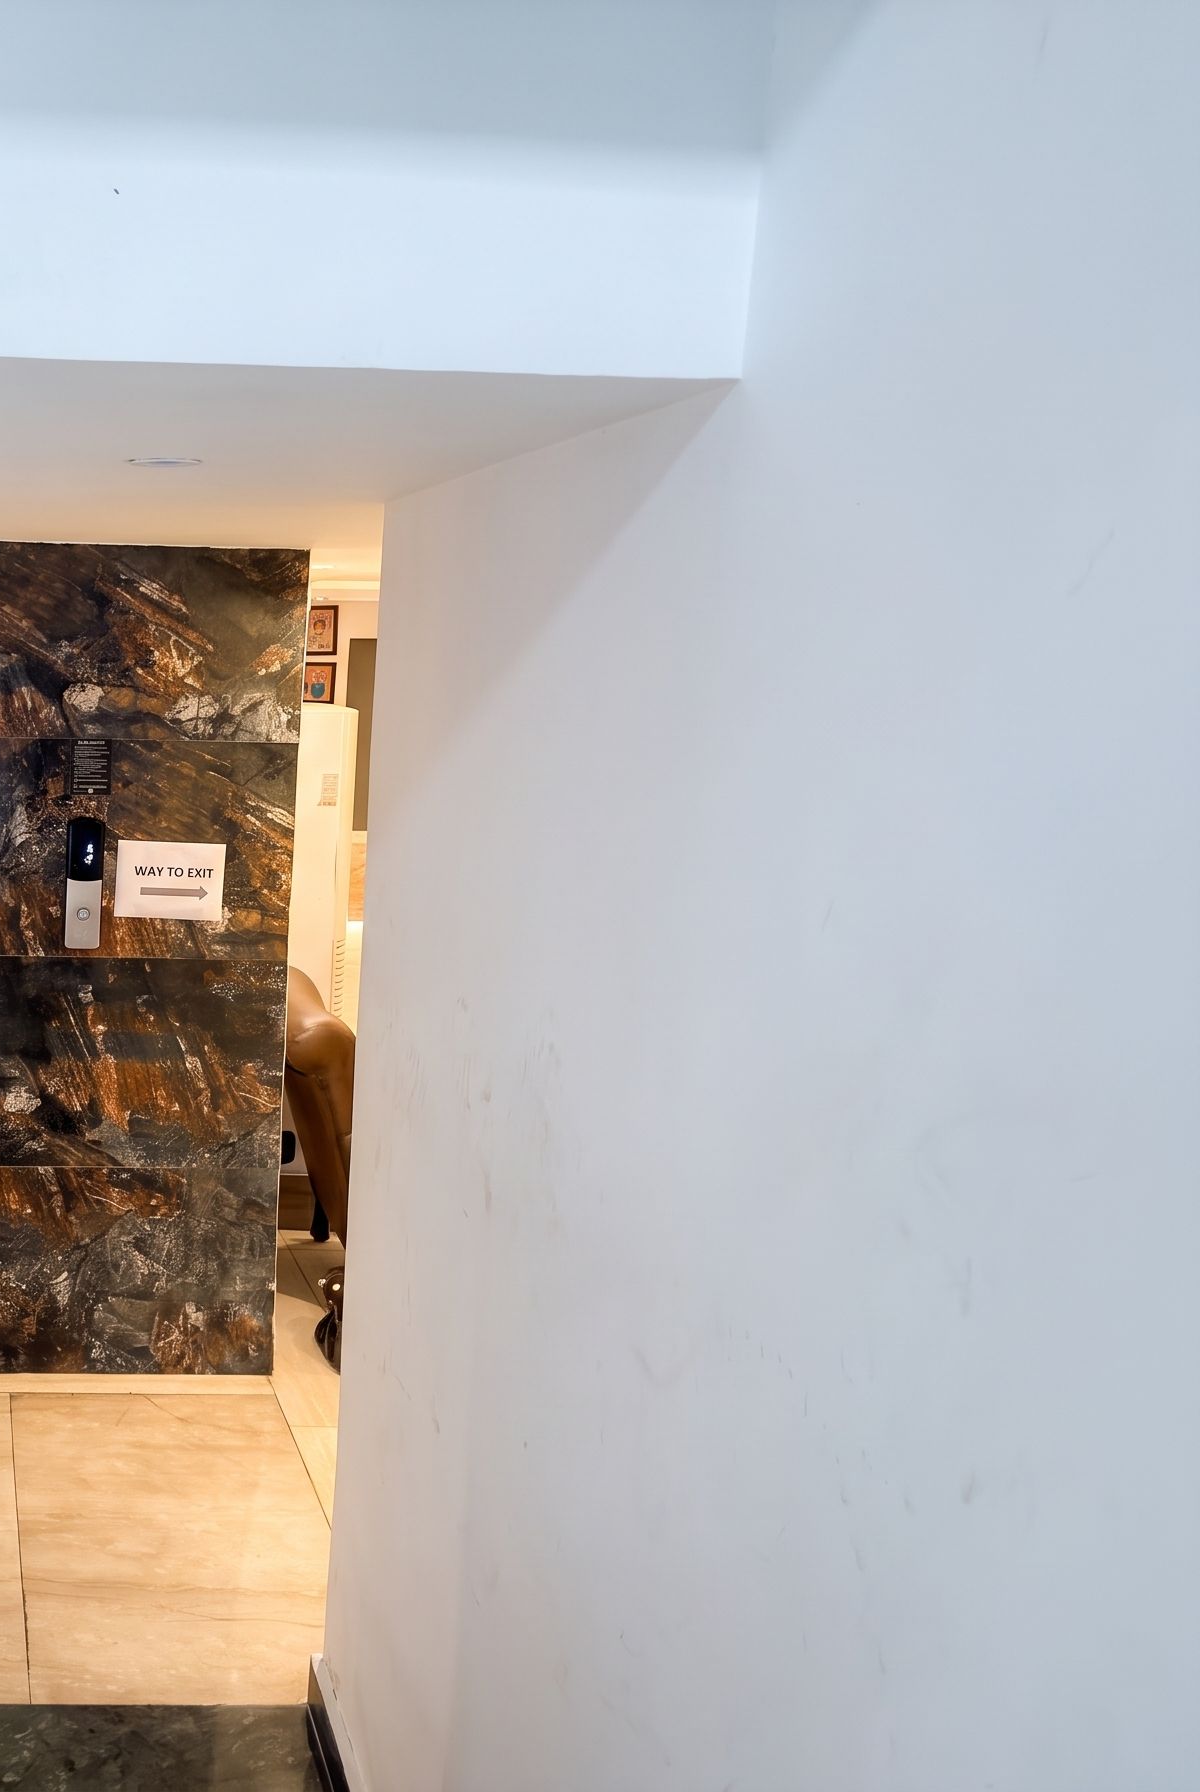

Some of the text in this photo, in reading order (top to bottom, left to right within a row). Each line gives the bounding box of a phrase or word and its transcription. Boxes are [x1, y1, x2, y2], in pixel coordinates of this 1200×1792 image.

[134, 865, 214, 878] WAY TO EXIT
